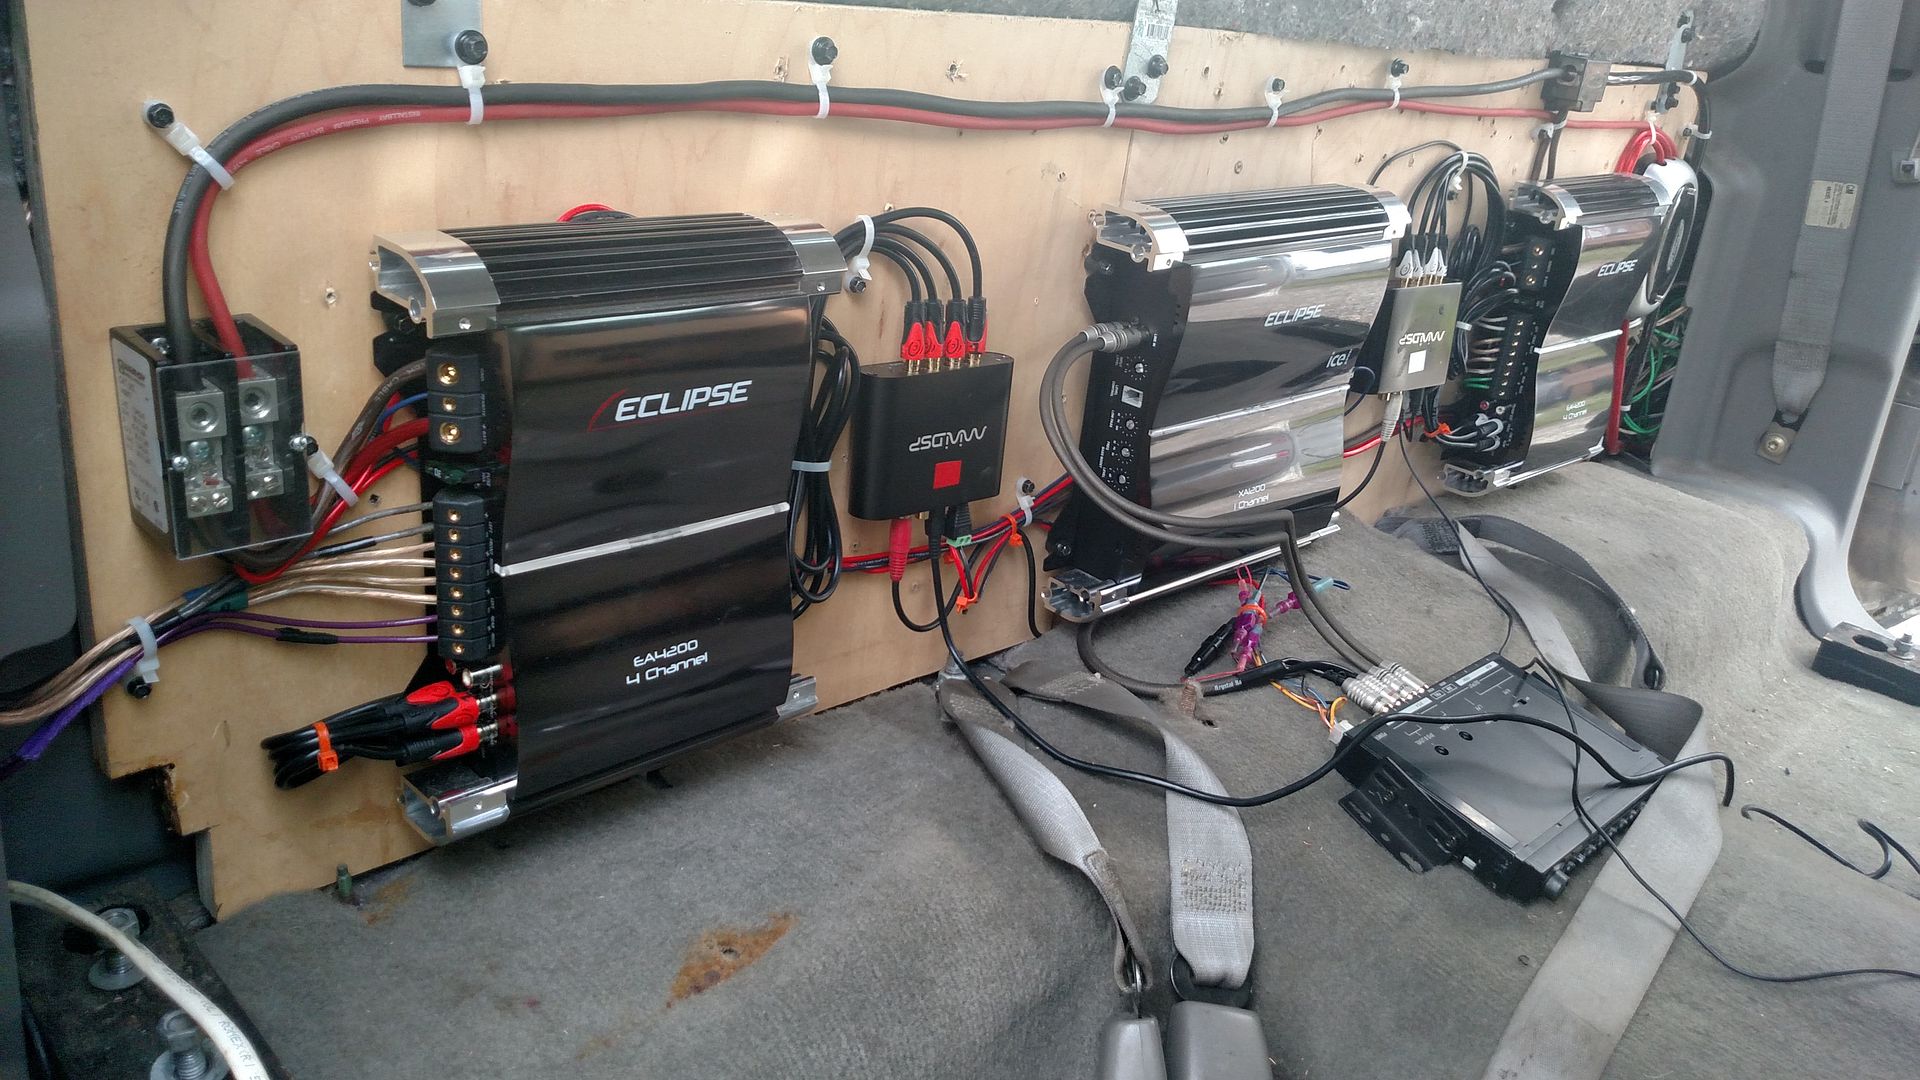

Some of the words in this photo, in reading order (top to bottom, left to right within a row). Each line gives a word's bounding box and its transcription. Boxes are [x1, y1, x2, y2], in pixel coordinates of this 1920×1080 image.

[333, 117, 370, 130] PREMIUM
[1597, 258, 1639, 277] ECLIPSE
[1264, 303, 1326, 327] ECLIPSE
[372, 375, 401, 403] CABLE
[614, 379, 753, 422] ECLIPSE
[1238, 492, 1270, 509] Channel
[632, 638, 699, 667] EA4200
[625, 672, 641, 686] 4
[644, 651, 709, 681] Channel
